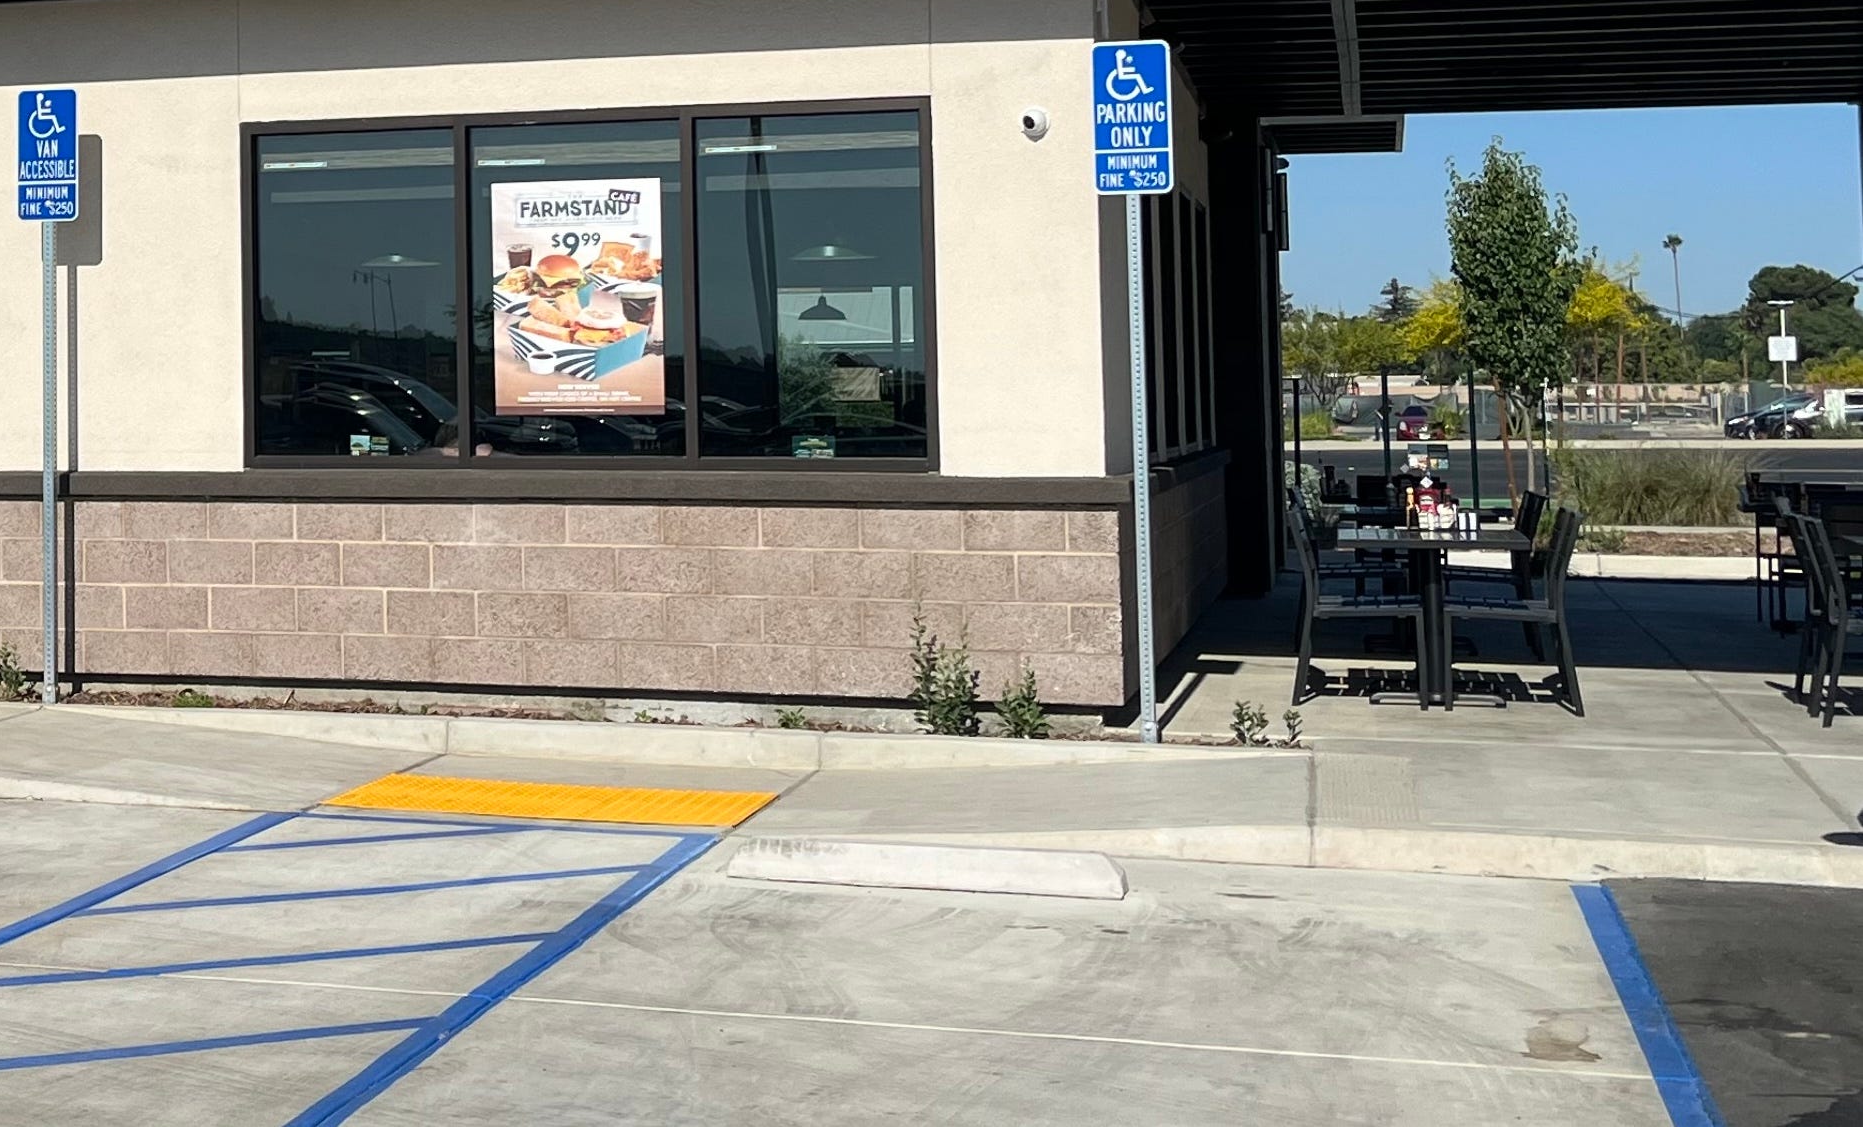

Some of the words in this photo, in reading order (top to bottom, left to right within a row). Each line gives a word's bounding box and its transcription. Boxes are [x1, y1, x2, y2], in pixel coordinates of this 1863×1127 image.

[1096, 101, 1166, 125] PARKING
[1110, 125, 1153, 148] ONLY
[36, 139, 59, 158] VAN
[19, 159, 75, 180] ACCESSIBLE
[1107, 154, 1158, 170] MINIMUM
[1099, 173, 1125, 188] FINE
[1133, 171, 1167, 187] $250
[25, 186, 69, 200] MINIMUM
[20, 202, 42, 216] FINE
[49, 201, 74, 216] $250
[520, 199, 630, 218] FARMSTAND
